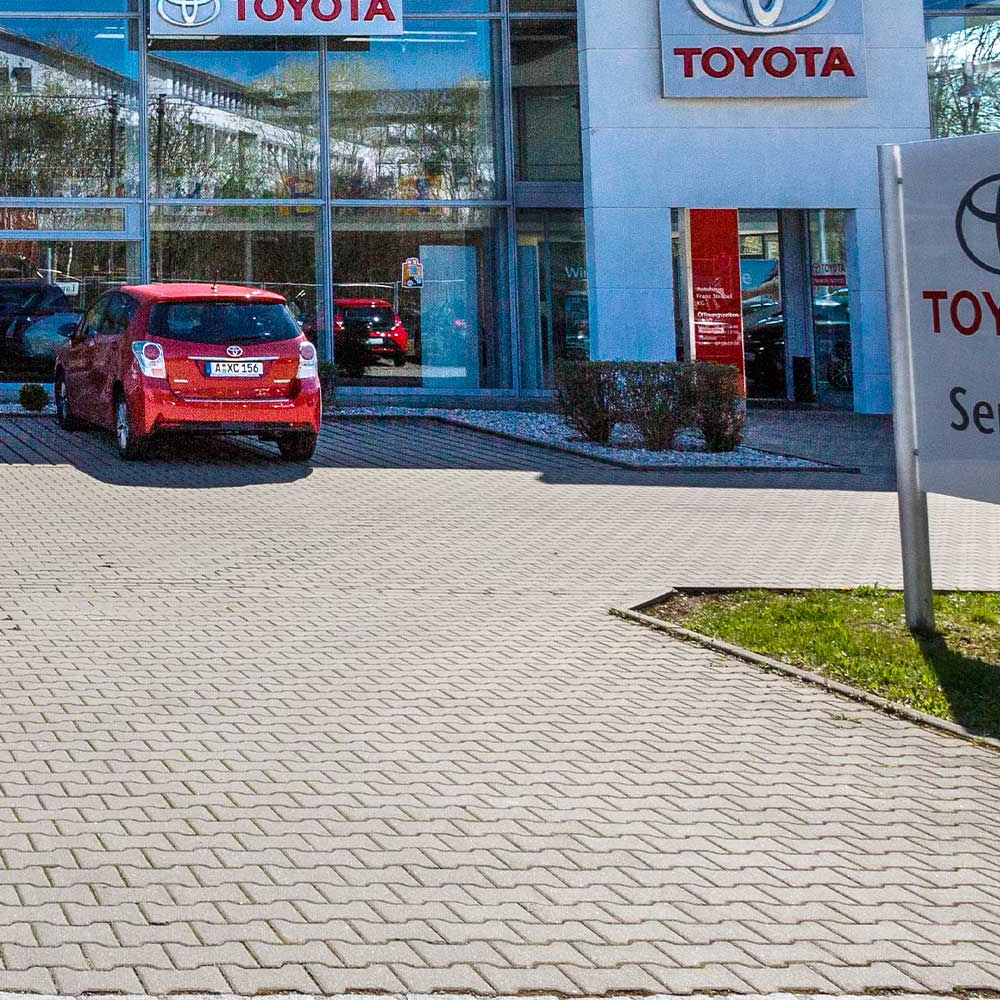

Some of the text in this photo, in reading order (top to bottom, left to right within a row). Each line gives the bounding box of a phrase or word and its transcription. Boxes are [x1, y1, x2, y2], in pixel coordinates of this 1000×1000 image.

[673, 46, 856, 78] TOYOTA
[215, 363, 259, 373] A XC 156
[949, 386, 1000, 435] Se
